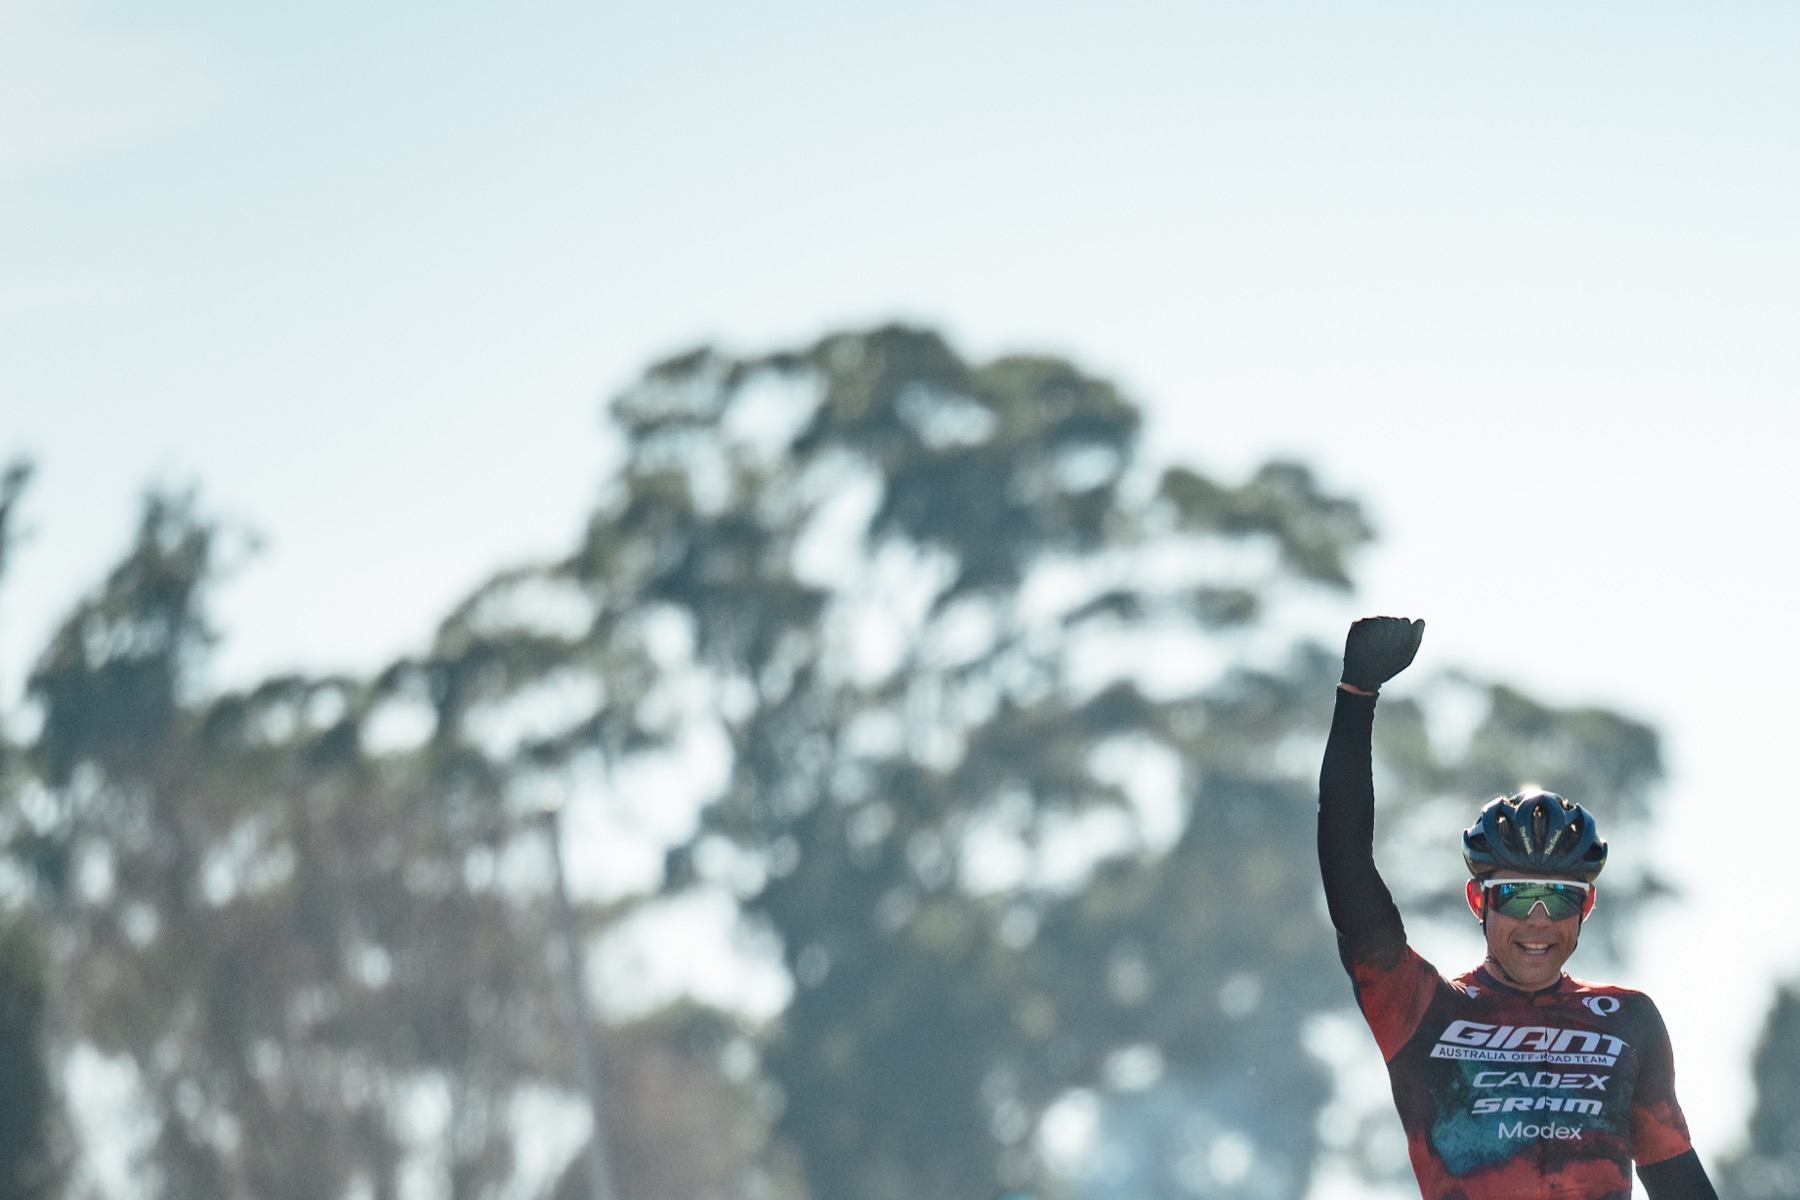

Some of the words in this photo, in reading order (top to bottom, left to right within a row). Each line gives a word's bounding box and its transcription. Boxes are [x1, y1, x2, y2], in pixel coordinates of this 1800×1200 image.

[1439, 1020, 1630, 1056] GIANT
[1438, 1047, 1506, 1061] AUSTRALIA
[1575, 1055, 1608, 1065] TEAM
[1473, 1071, 1611, 1091] CADEX
[1471, 1096, 1604, 1116] SRAM
[1497, 1121, 1582, 1140] Modex
